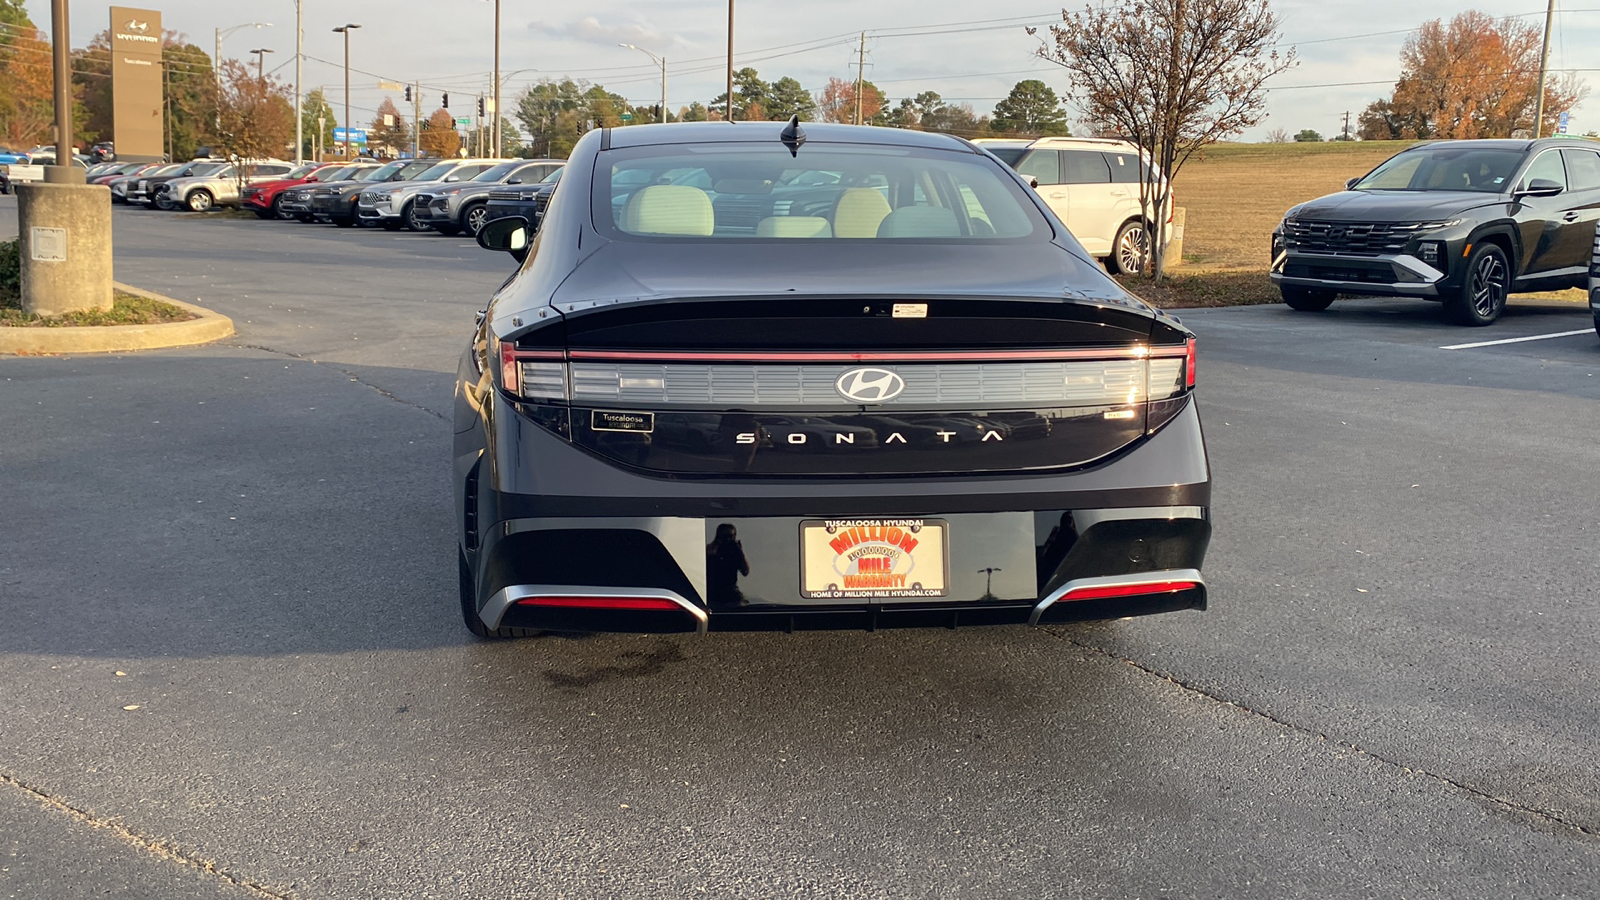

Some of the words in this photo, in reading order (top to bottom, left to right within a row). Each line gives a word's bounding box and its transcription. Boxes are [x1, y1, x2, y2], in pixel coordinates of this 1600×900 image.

[603, 413, 643, 422] Tuscaloosa
[735, 430, 1004, 444] SONATA
[824, 520, 882, 528] TUSCALOOSA
[883, 519, 924, 527] HYUNDAI
[828, 525, 919, 556] MILLION
[857, 557, 891, 574] MILE
[842, 574, 907, 588] WARRANTY
[844, 590, 873, 598] MILLION
[891, 589, 942, 597] HYUNDAI.COM
